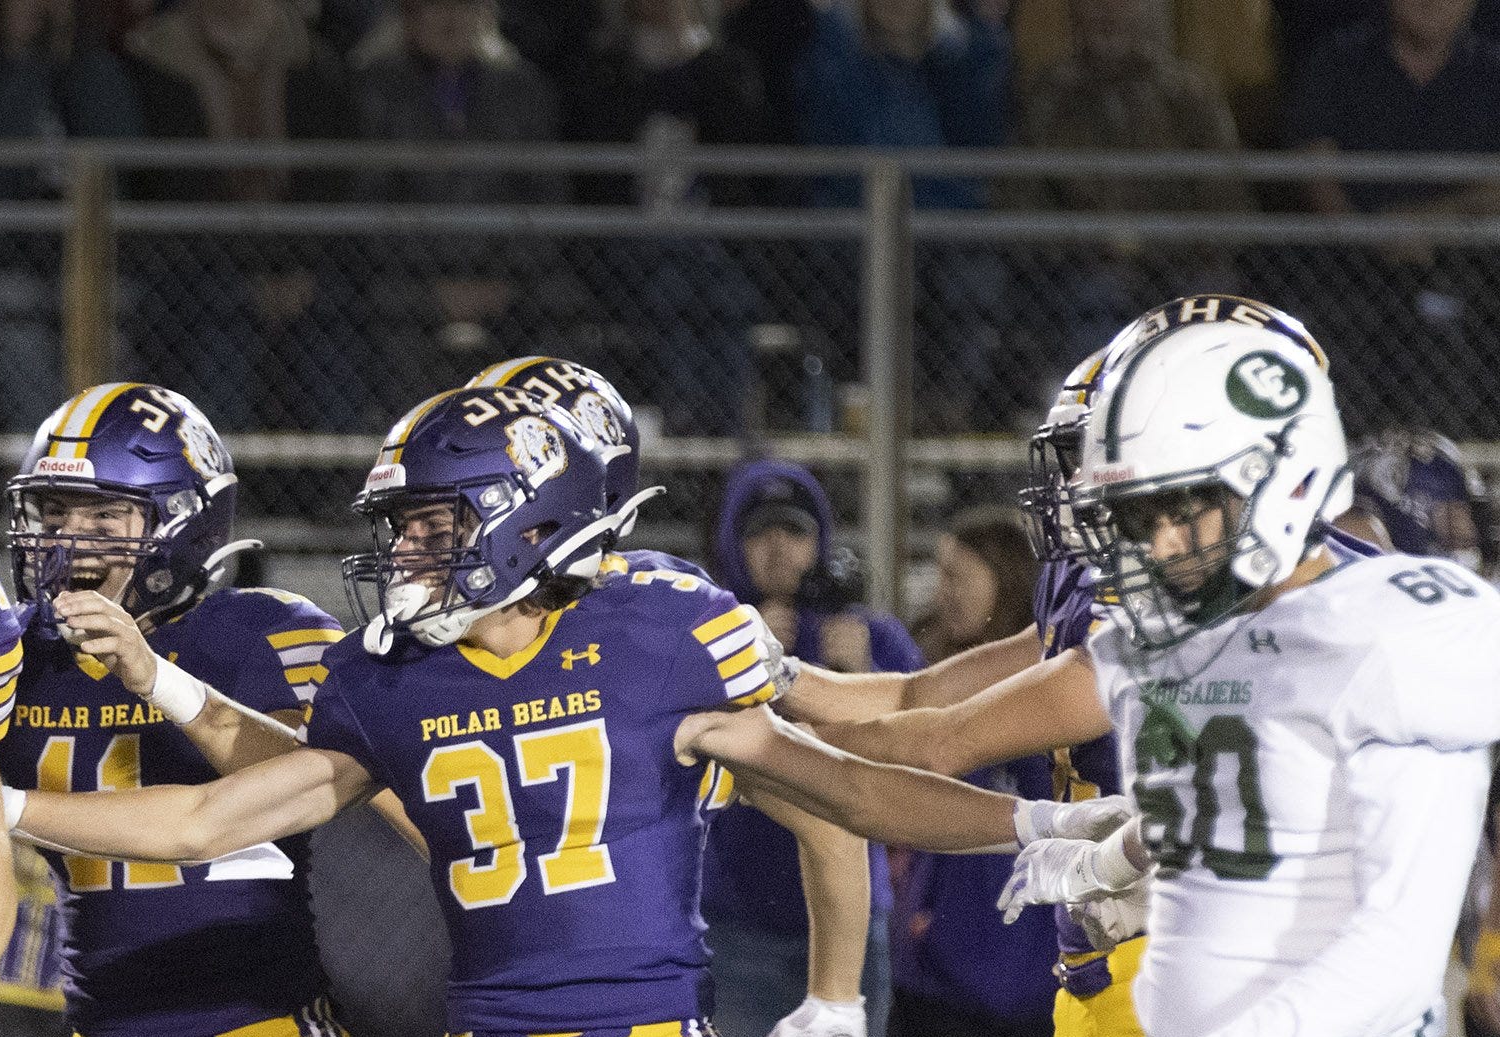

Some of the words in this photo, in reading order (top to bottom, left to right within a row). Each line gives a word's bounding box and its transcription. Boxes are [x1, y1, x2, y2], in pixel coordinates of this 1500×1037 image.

[461, 391, 542, 427] JH
[523, 363, 590, 411] JH
[39, 460, 84, 473] Riddell
[15, 705, 90, 729] POLAR
[100, 703, 164, 727] BEAR
[422, 709, 502, 742] POLAR
[513, 689, 602, 726] BEARS
[37, 733, 186, 892] 11
[421, 717, 617, 911] 37
[1132, 713, 1284, 882] 60
